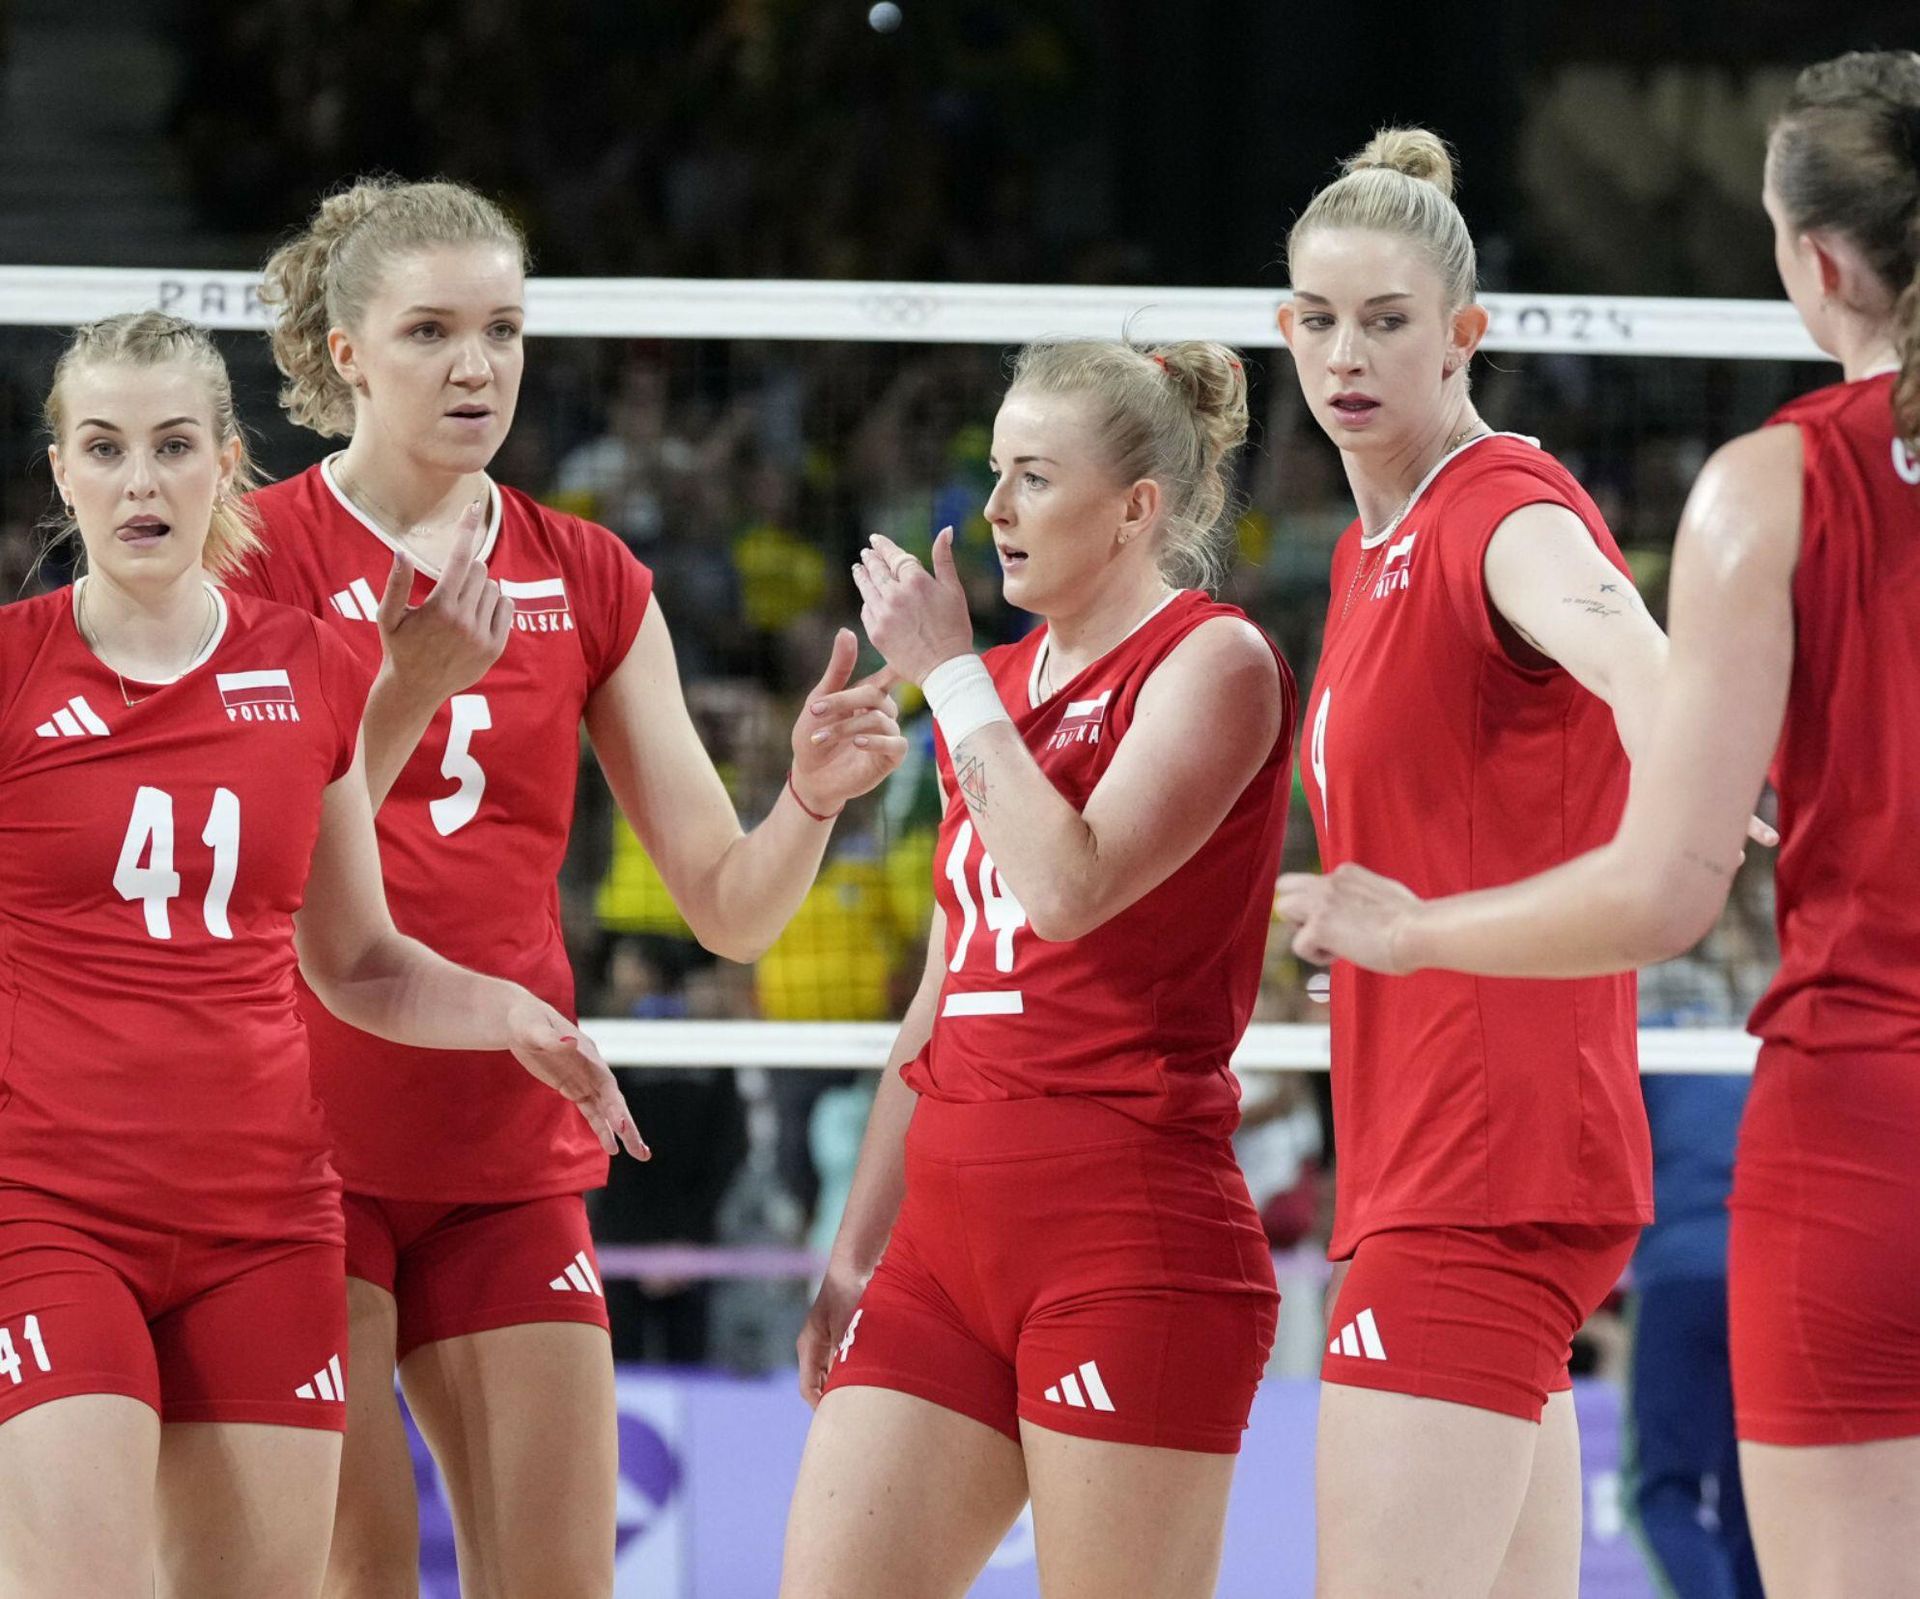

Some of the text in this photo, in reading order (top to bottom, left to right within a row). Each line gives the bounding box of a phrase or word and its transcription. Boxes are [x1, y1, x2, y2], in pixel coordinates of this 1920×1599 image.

[511, 612, 574, 633] OLSKA
[226, 703, 300, 722] POLSKA
[429, 693, 492, 837] 5
[112, 785, 241, 940] 41
[945, 818, 1027, 974] 14
[0, 1314, 52, 1385] 41
[834, 1308, 864, 1363] 4
